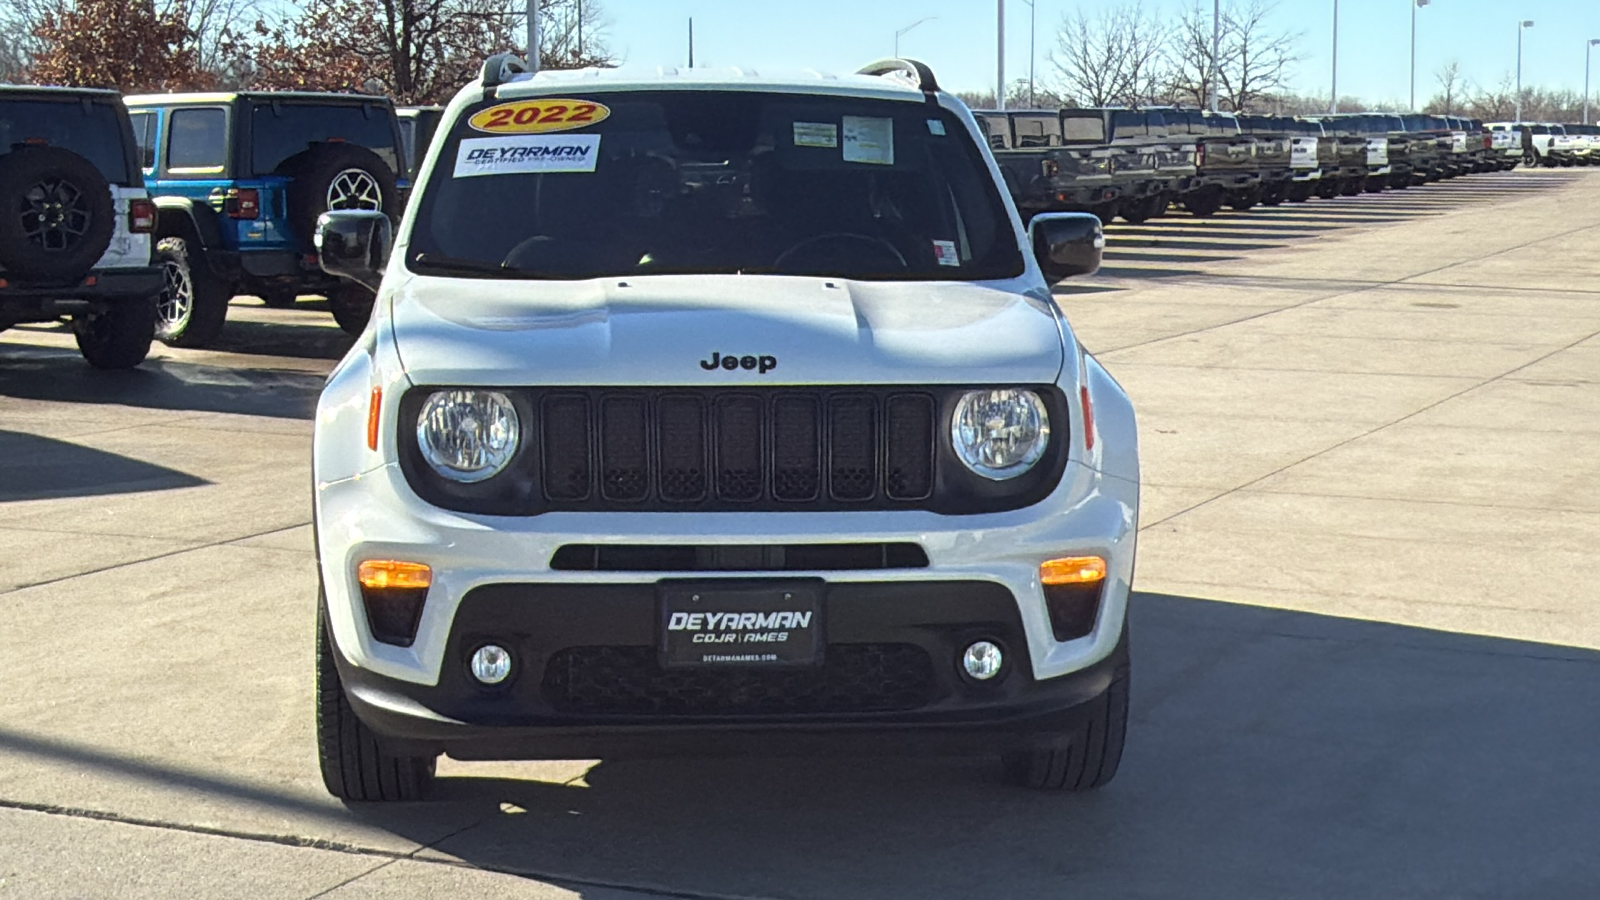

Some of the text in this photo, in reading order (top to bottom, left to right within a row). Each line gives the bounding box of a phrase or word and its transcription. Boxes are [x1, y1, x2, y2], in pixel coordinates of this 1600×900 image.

[483, 104, 597, 128] 2022
[466, 145, 591, 161] DEYARMAN
[700, 352, 777, 374] Jeep
[668, 611, 813, 630] DEYARMAN
[743, 632, 789, 642] AMES
